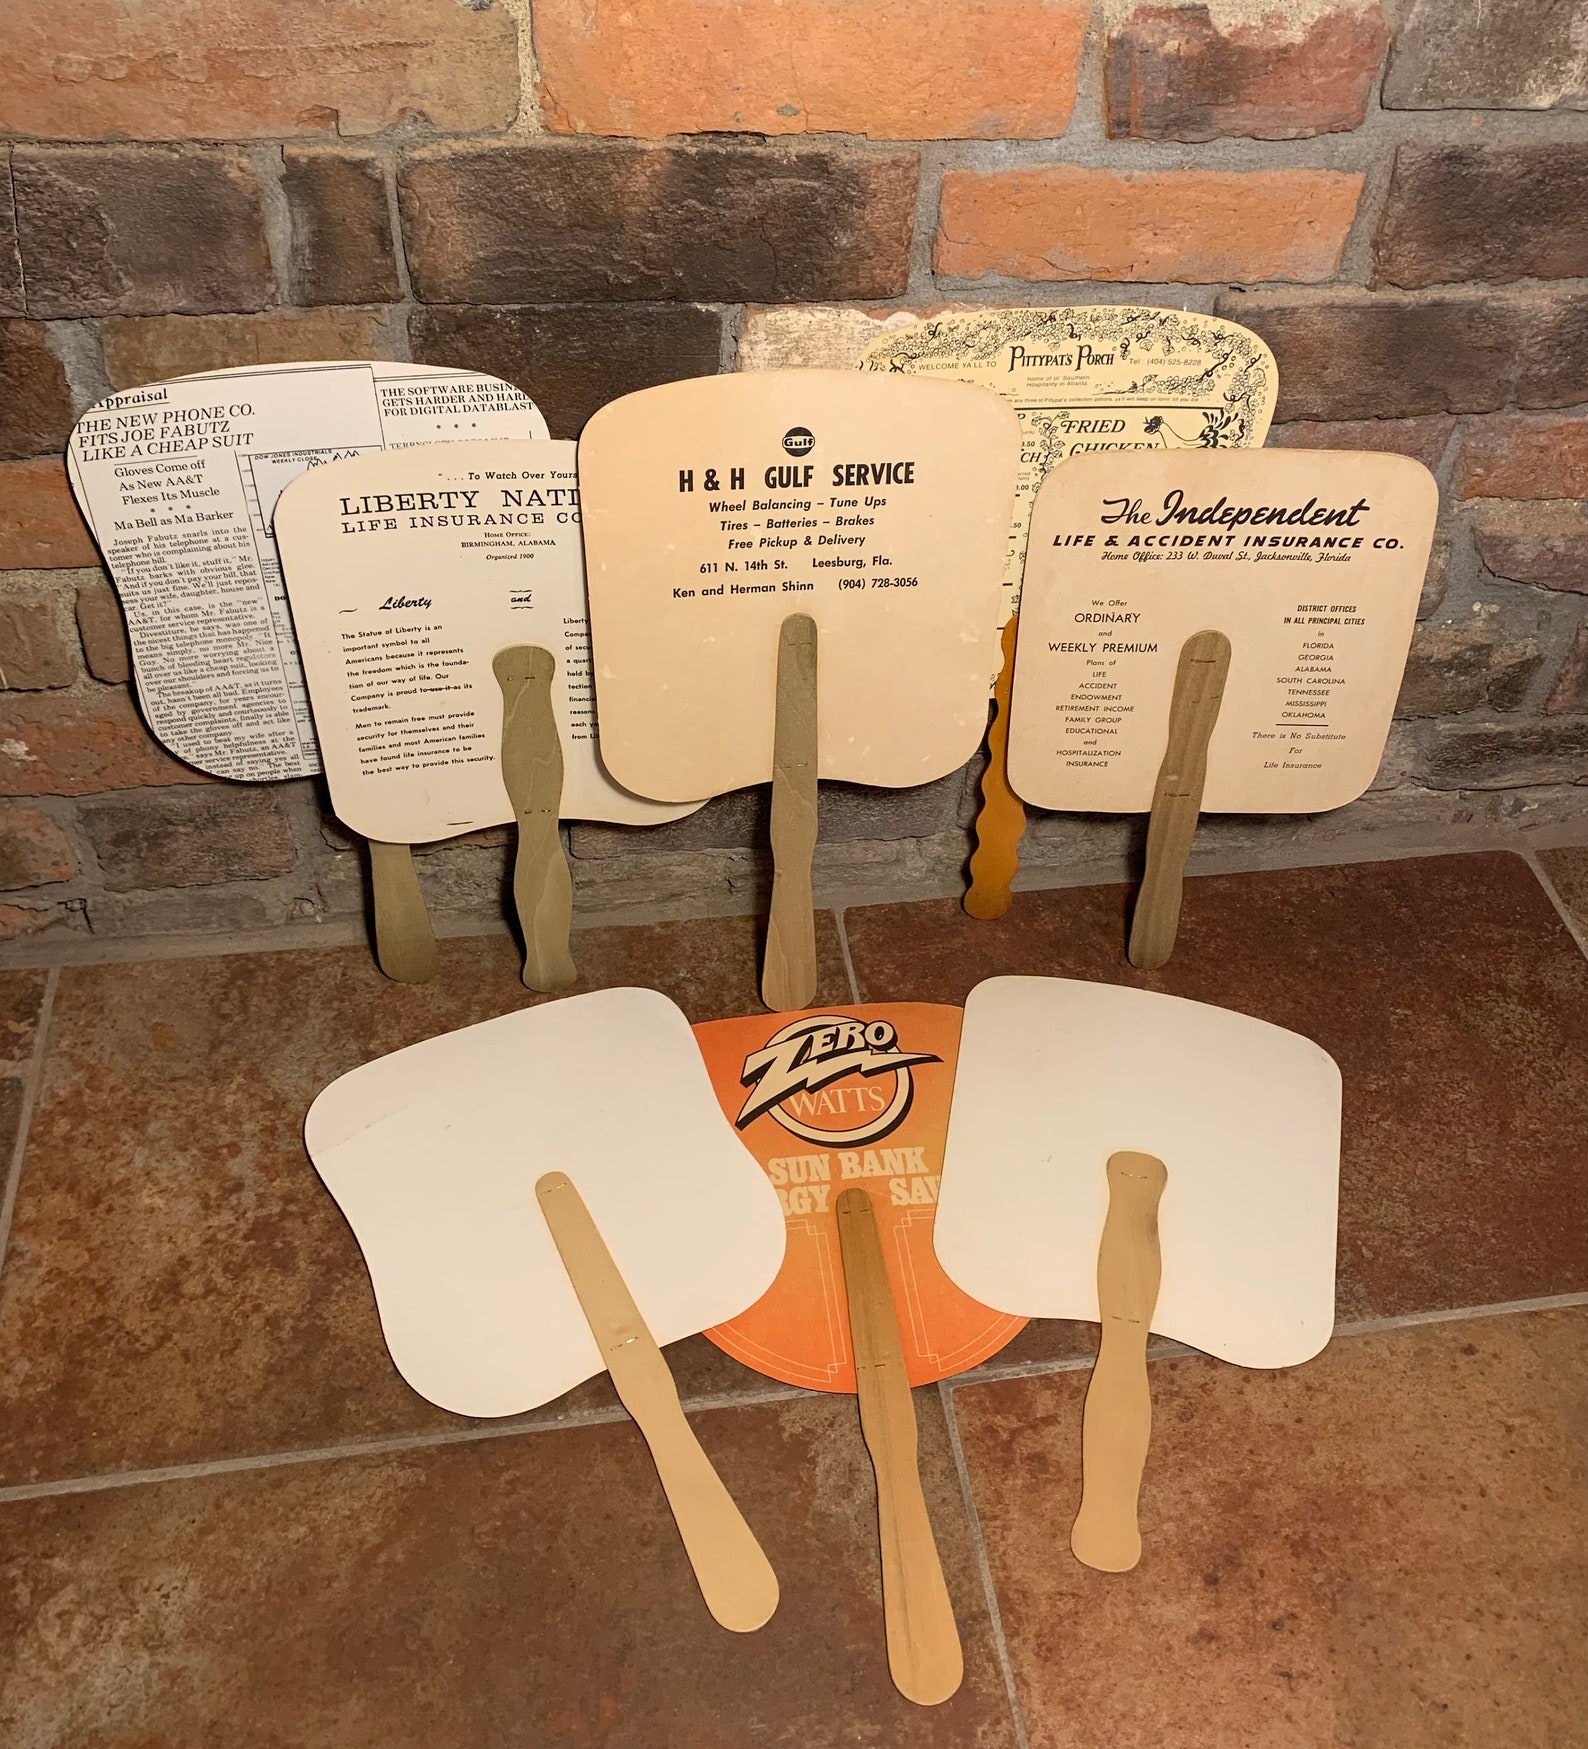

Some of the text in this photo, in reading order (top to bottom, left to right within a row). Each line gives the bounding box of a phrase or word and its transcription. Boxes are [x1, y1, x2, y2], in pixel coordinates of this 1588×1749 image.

[1075, 344, 1115, 371] PORCH
[380, 384, 474, 397] THE SOFTWARE
[382, 393, 493, 406] GETS HARDER AND
[384, 399, 535, 416] FOR DIGITAL DATABLAST
[75, 403, 254, 433] THE NEW PHONE CO.
[1060, 419, 1125, 433] FRIED
[79, 420, 229, 448] FITS JOE FABUTZ
[784, 438, 813, 446] Gulf
[83, 432, 253, 461] LIKE A CHEAP SUIT
[114, 459, 205, 477] Gloves Come off
[521, 471, 544, 479] Over
[679, 461, 914, 492] H & H GULF SERVICE
[119, 473, 202, 491] As New AA&T
[121, 486, 219, 505] Flexes Its Muscle
[339, 490, 479, 515] LIBERTY
[709, 496, 886, 512] Wheel Balancing Tune Ups
[1100, 490, 1370, 531] The Independent
[113, 520, 133, 530] Ma
[134, 517, 157, 528] Bell
[174, 514, 193, 523] Ma
[195, 510, 233, 521] Barker
[341, 518, 397, 533] LIFE
[409, 512, 543, 528] INSURANCE
[720, 514, 874, 530] Tires Batteries Brakes
[113, 536, 143, 547] Joseph
[146, 534, 179, 545] Fabutz
[182, 529, 208, 540] snarls
[212, 529, 229, 537] into
[728, 534, 865, 549] Free Pickup & Delivery
[1052, 535, 1403, 549] LIFE & ACCIDENT INSURANCE CO.
[699, 554, 892, 573] 611 N. 14th St. Leesburg, Fla.
[1101, 551, 1351, 563] Home Office: 233 Duval Jacksonville, Florida
[673, 576, 918, 598] Ken and Herman Shinn (904) 728-3056
[378, 593, 531, 611] Liberty and
[1074, 612, 1140, 623] ORDINARY
[1048, 642, 1157, 652] WEEKLY PREMIUM
[345, 656, 382, 664] Americans
[356, 733, 384, 741] security
[400, 726, 439, 734] themselves
[735, 1020, 944, 1130] ZERO
[788, 1086, 886, 1118] WATTS
[768, 1146, 929, 1186] SUN BANK
